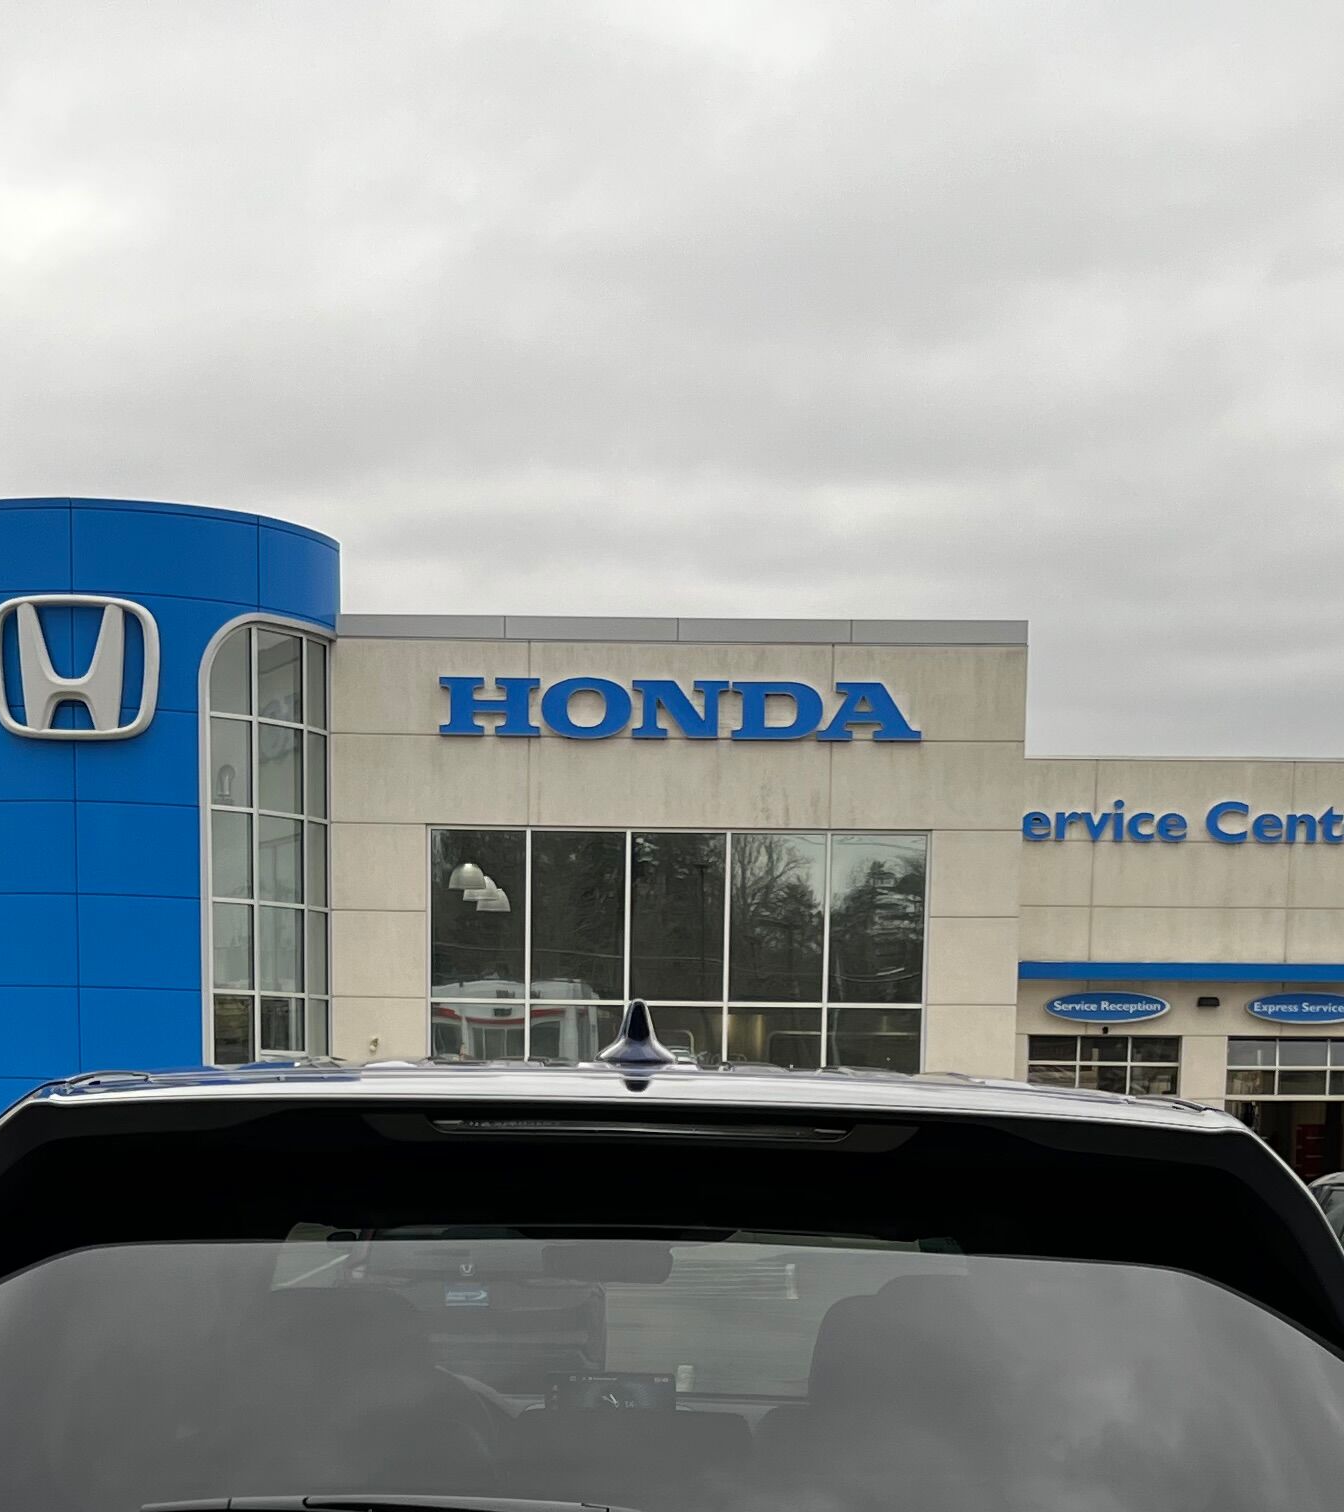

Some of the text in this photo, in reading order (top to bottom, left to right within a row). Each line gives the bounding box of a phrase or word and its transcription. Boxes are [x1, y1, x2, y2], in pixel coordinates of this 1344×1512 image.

[438, 675, 923, 742] HONDA
[1022, 799, 1188, 842] ervice
[1053, 1001, 1161, 1013] Service Reception
[1253, 1002, 1344, 1014] Express Service
